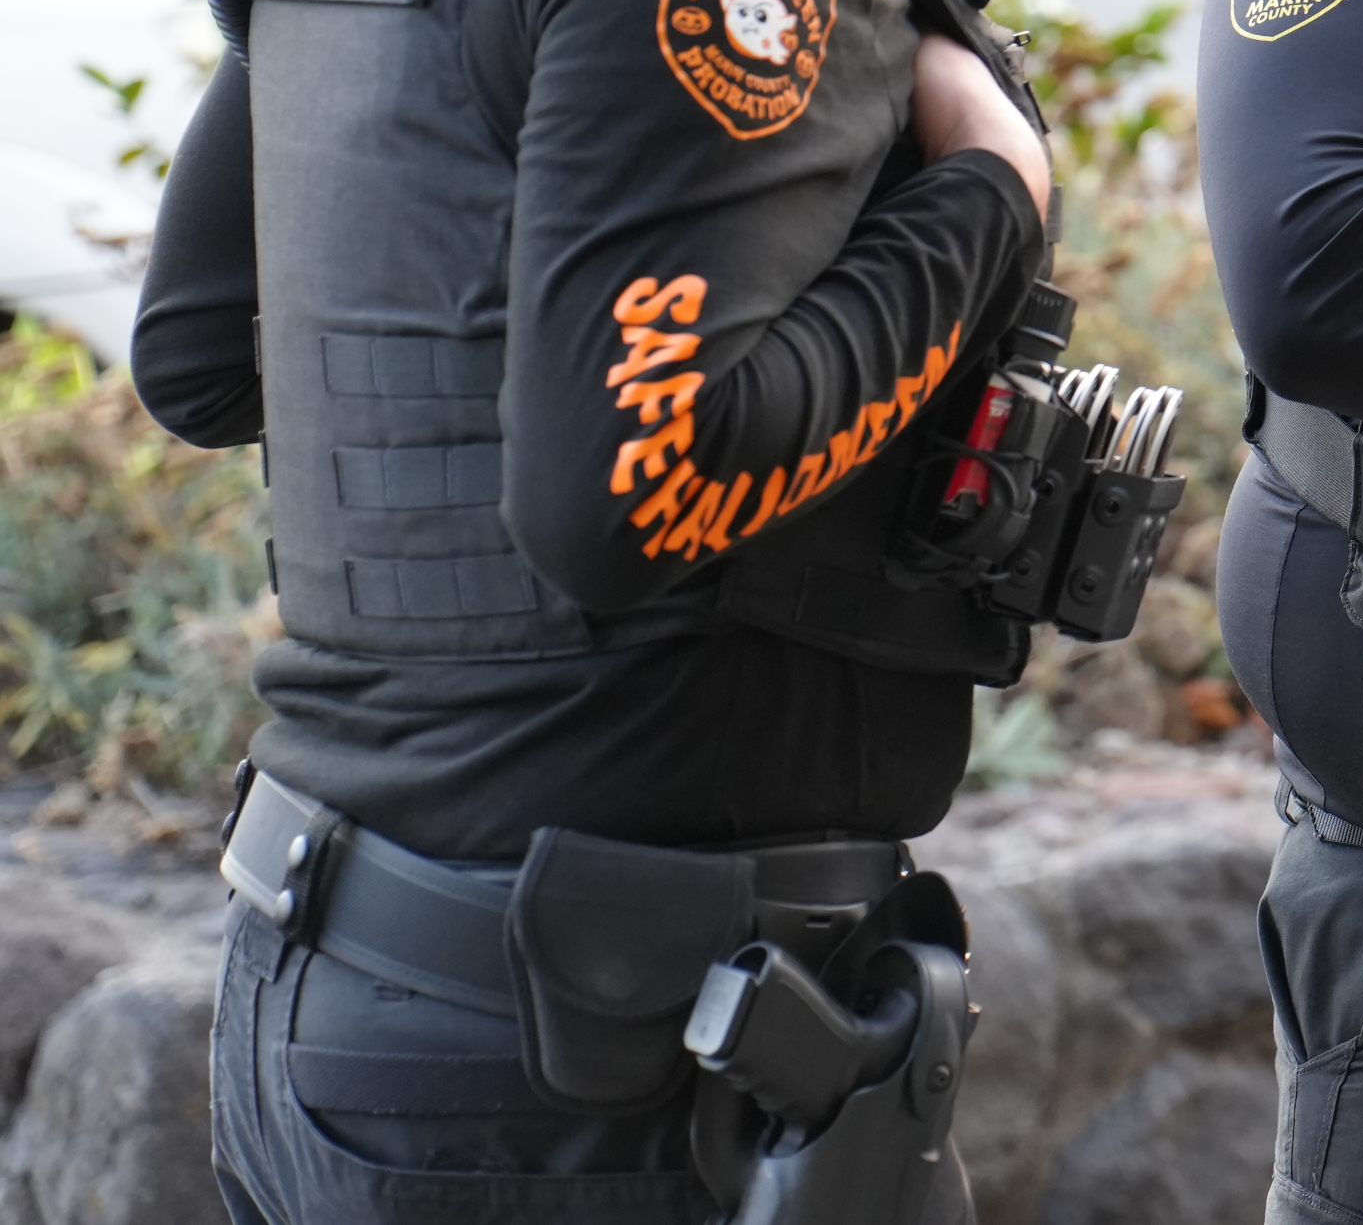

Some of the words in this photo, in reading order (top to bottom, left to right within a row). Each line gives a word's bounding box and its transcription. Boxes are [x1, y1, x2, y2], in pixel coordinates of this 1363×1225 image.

[1248, 3, 1314, 27] COUNTY
[676, 44, 801, 121] PROBATION
[604, 274, 708, 495] SAFE
